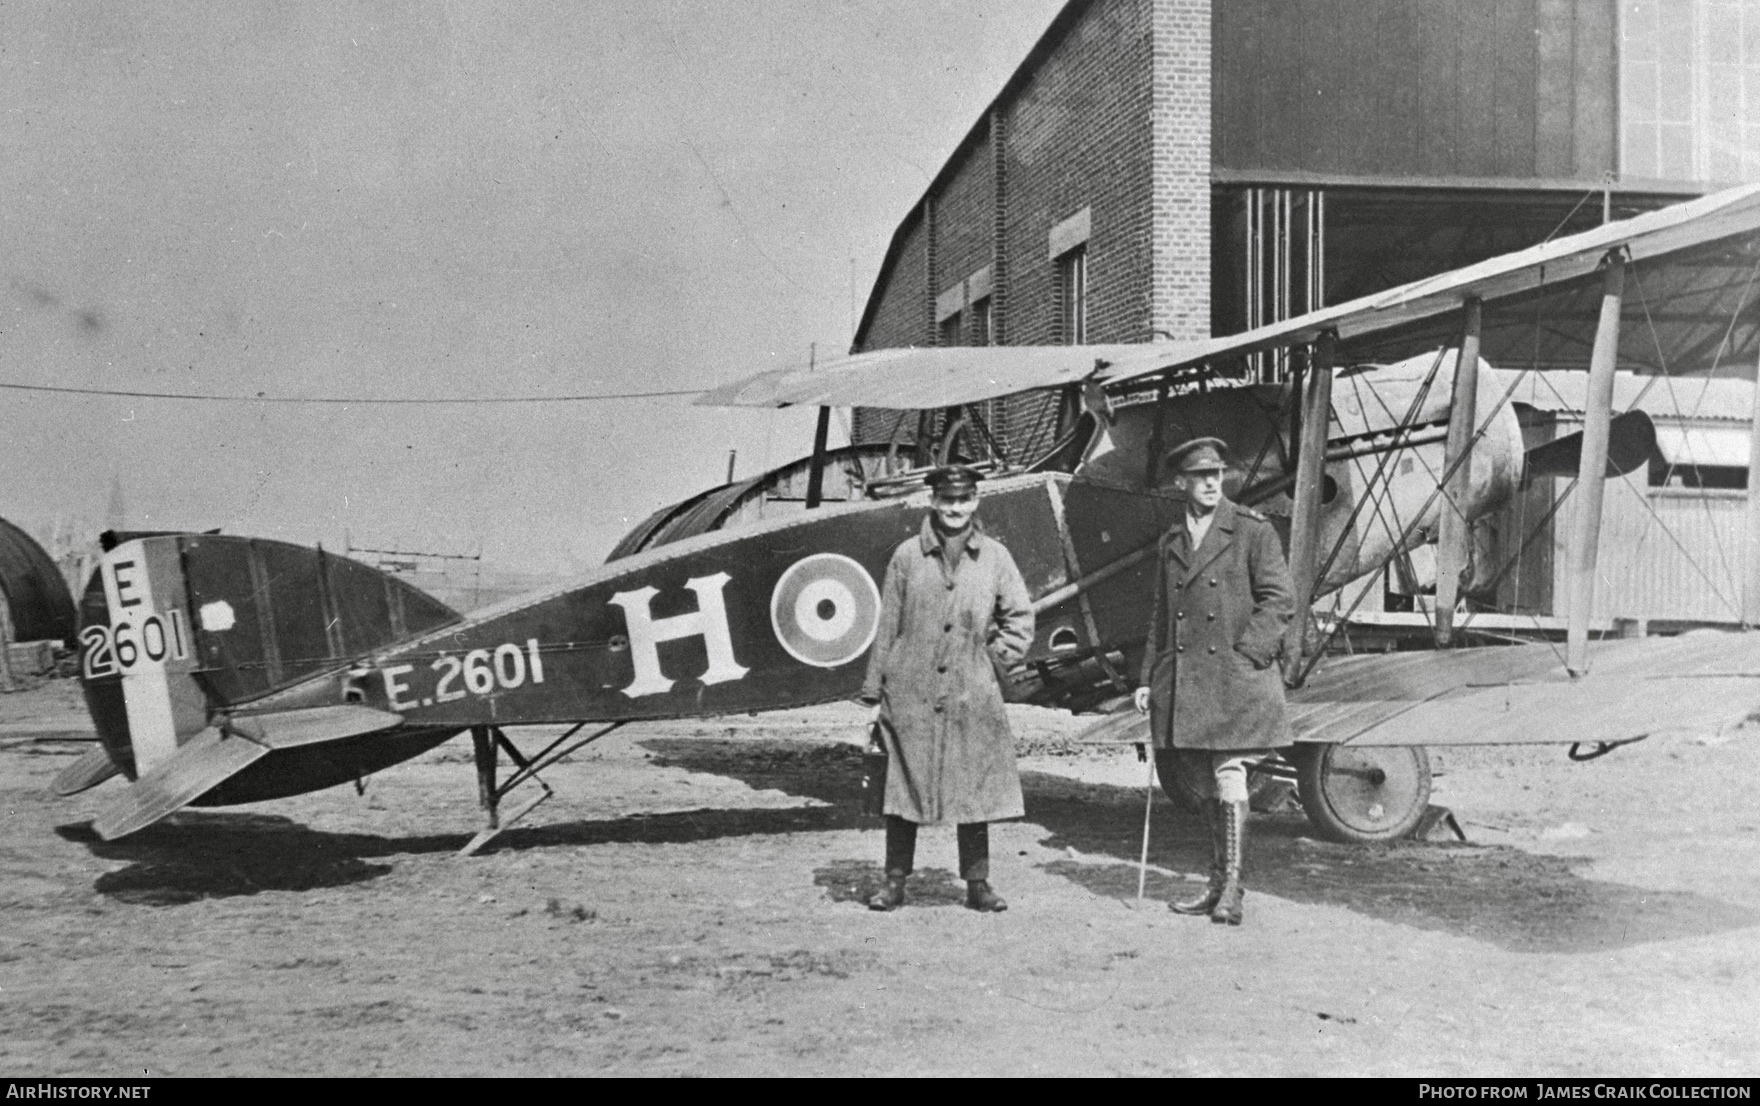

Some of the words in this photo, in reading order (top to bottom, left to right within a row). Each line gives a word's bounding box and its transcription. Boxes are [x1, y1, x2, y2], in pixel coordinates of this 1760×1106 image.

[113, 560, 143, 609] E
[79, 609, 190, 679] 2601
[607, 571, 751, 699] H
[382, 638, 545, 711] E.2601
